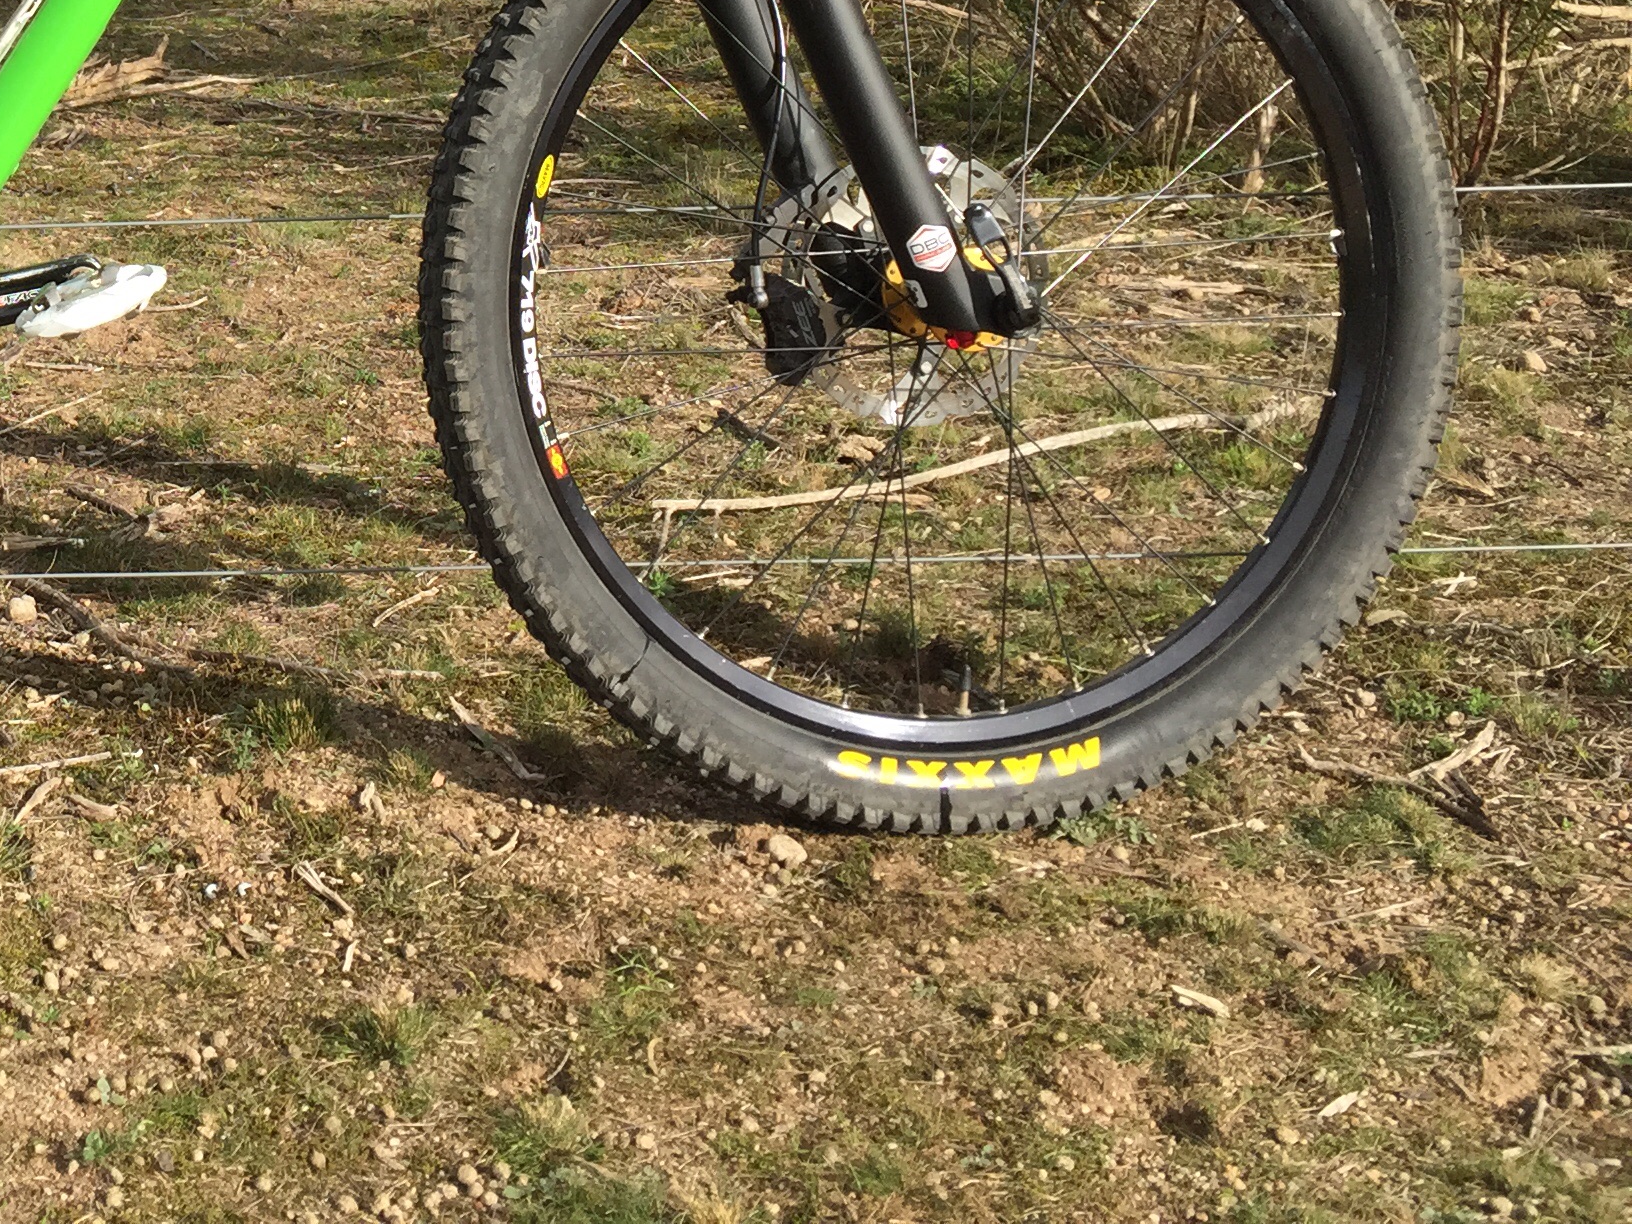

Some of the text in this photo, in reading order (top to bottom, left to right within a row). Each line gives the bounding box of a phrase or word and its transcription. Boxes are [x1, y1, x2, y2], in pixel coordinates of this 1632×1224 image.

[910, 233, 949, 256] DBC
[520, 271, 536, 332] 719
[791, 300, 819, 347] ZEE
[522, 337, 548, 419] DISC
[831, 736, 1101, 789] MAXXIS
